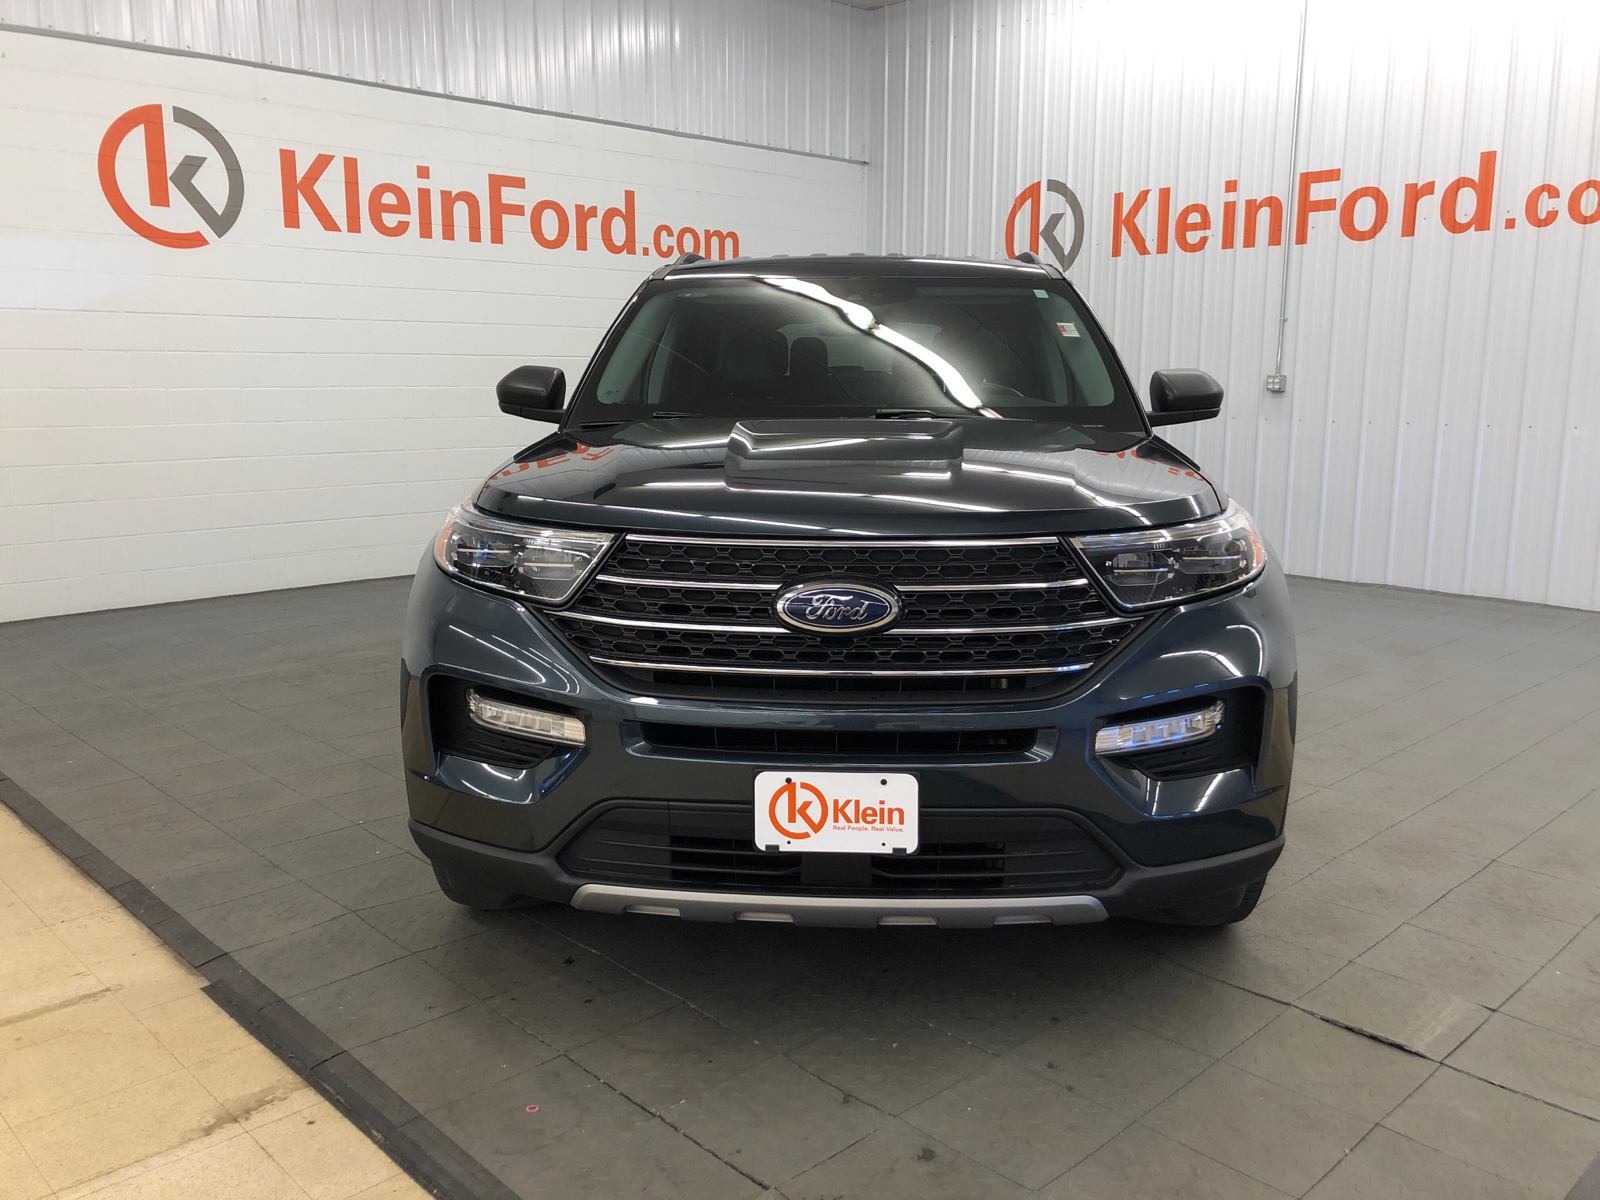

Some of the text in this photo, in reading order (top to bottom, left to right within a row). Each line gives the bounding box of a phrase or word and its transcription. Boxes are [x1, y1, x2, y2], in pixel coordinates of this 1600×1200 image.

[279, 149, 739, 260] KleinFord.com
[805, 593, 868, 620] Ford
[833, 799, 904, 825] Klein
